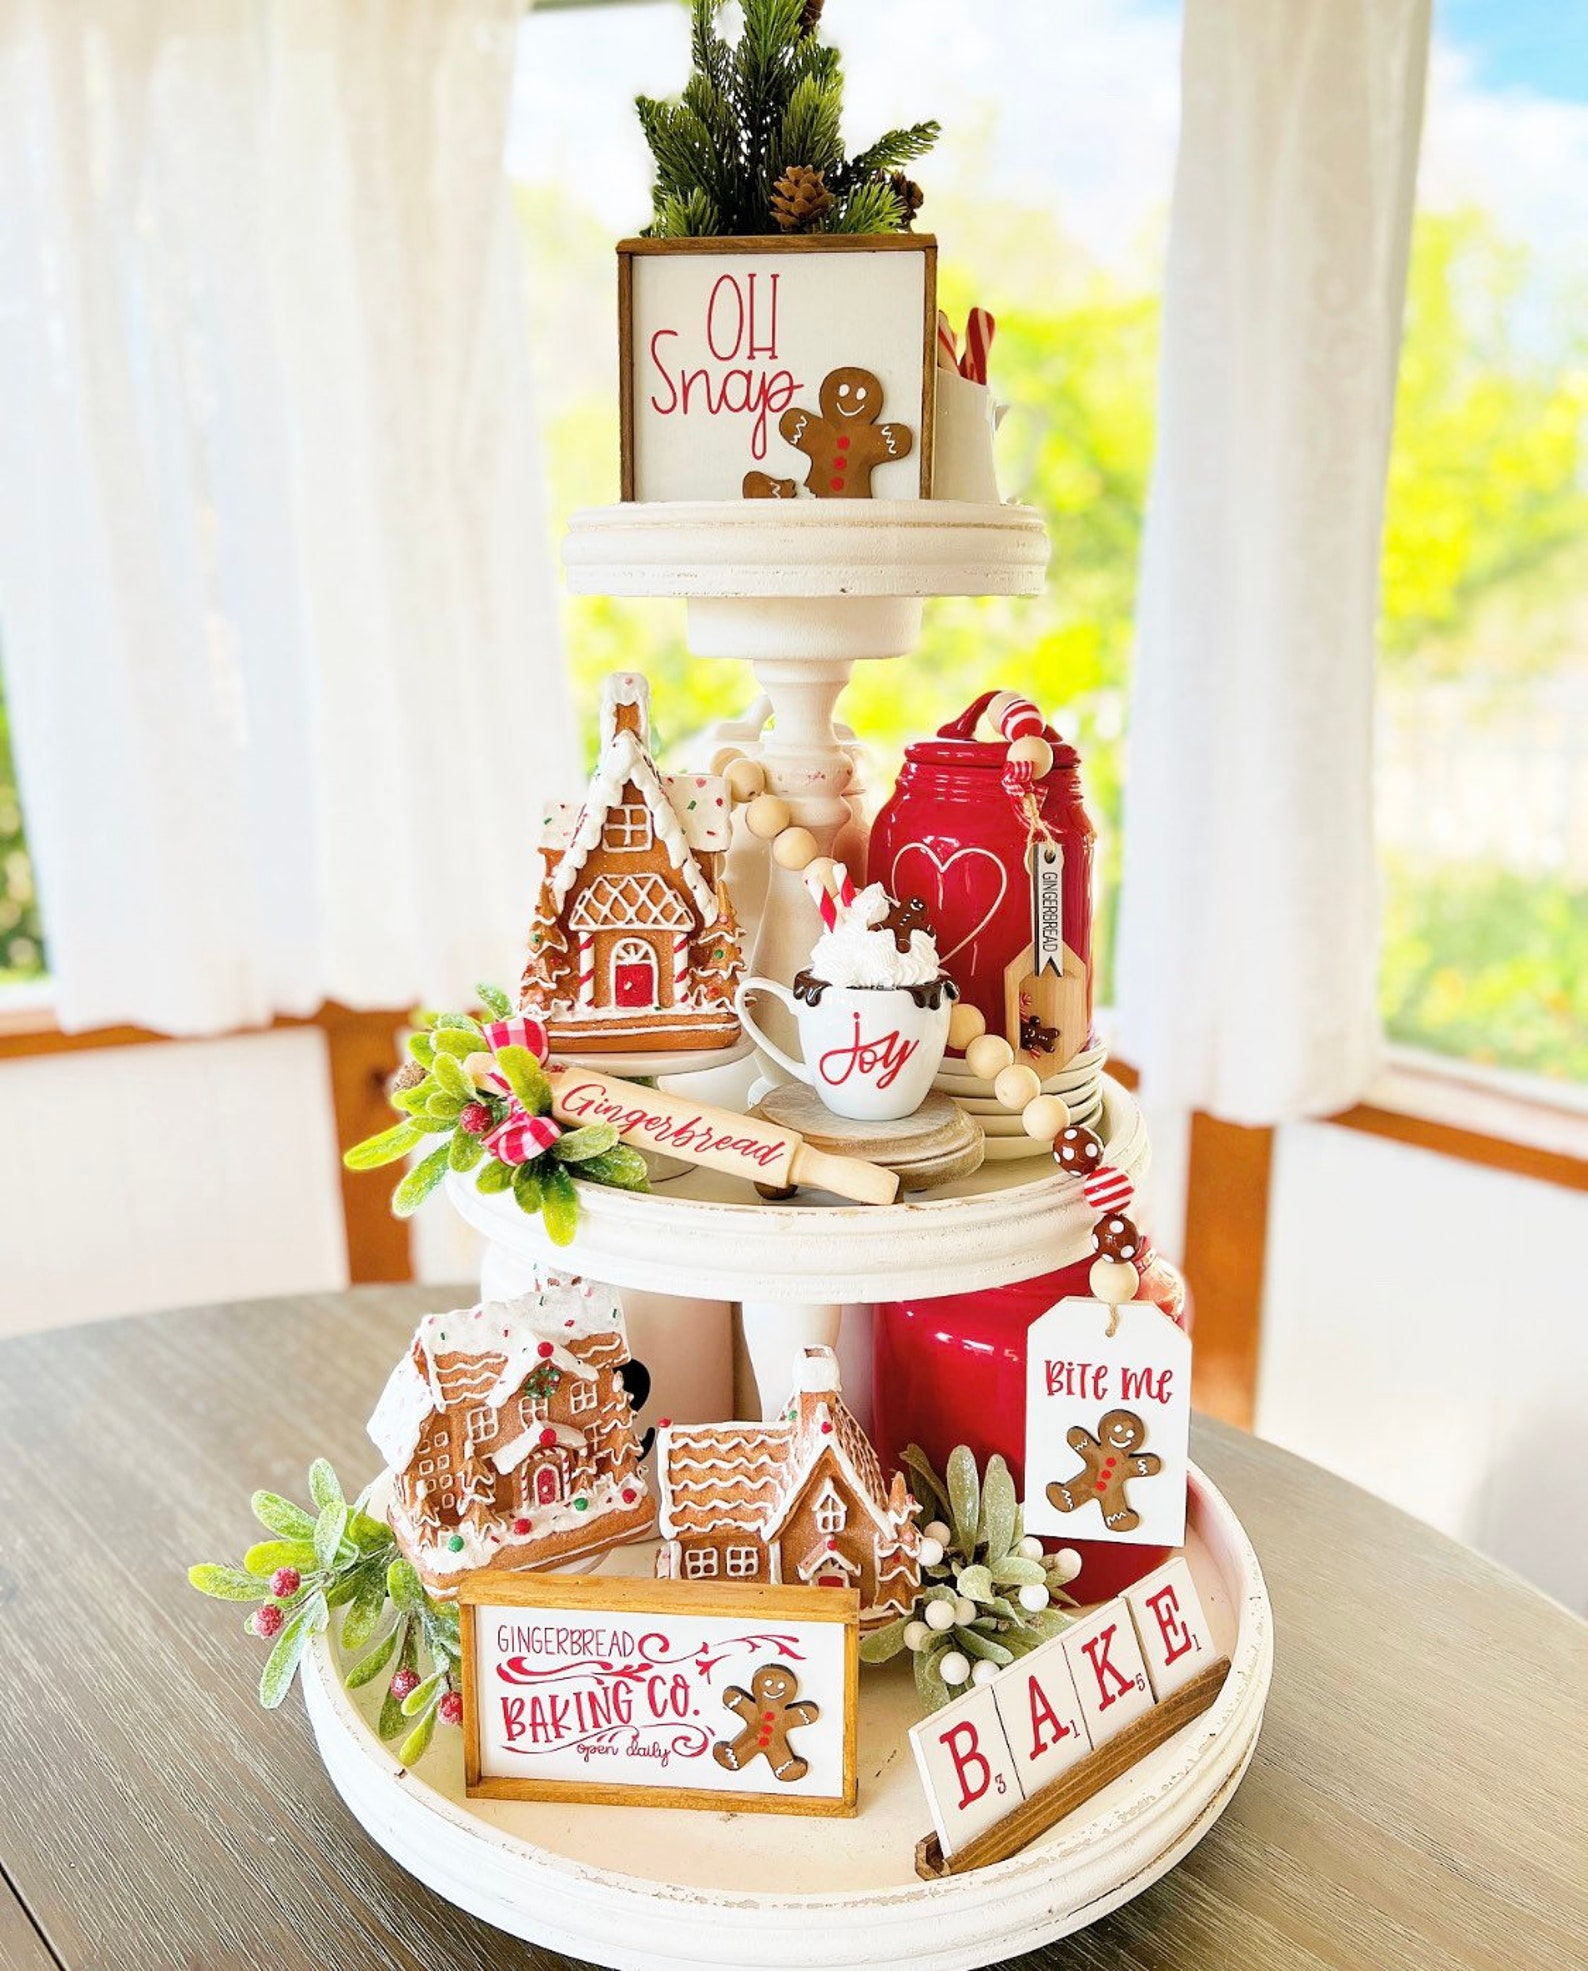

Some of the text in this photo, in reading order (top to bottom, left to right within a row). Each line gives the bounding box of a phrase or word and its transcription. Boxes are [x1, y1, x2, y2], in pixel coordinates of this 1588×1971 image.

[707, 272, 780, 361] OH
[650, 329, 804, 460] Snap
[1042, 871, 1058, 953] GINGERBREAD
[818, 1011, 919, 1089] joy
[560, 1083, 787, 1167] Gingerbread
[497, 1625, 635, 1657] GINGERBREAD
[500, 1673, 700, 1743] BAKING CO.
[939, 1584, 1193, 1811] BAKE
[576, 1737, 672, 1767] open daily
[994, 1773, 1007, 1794] 3
